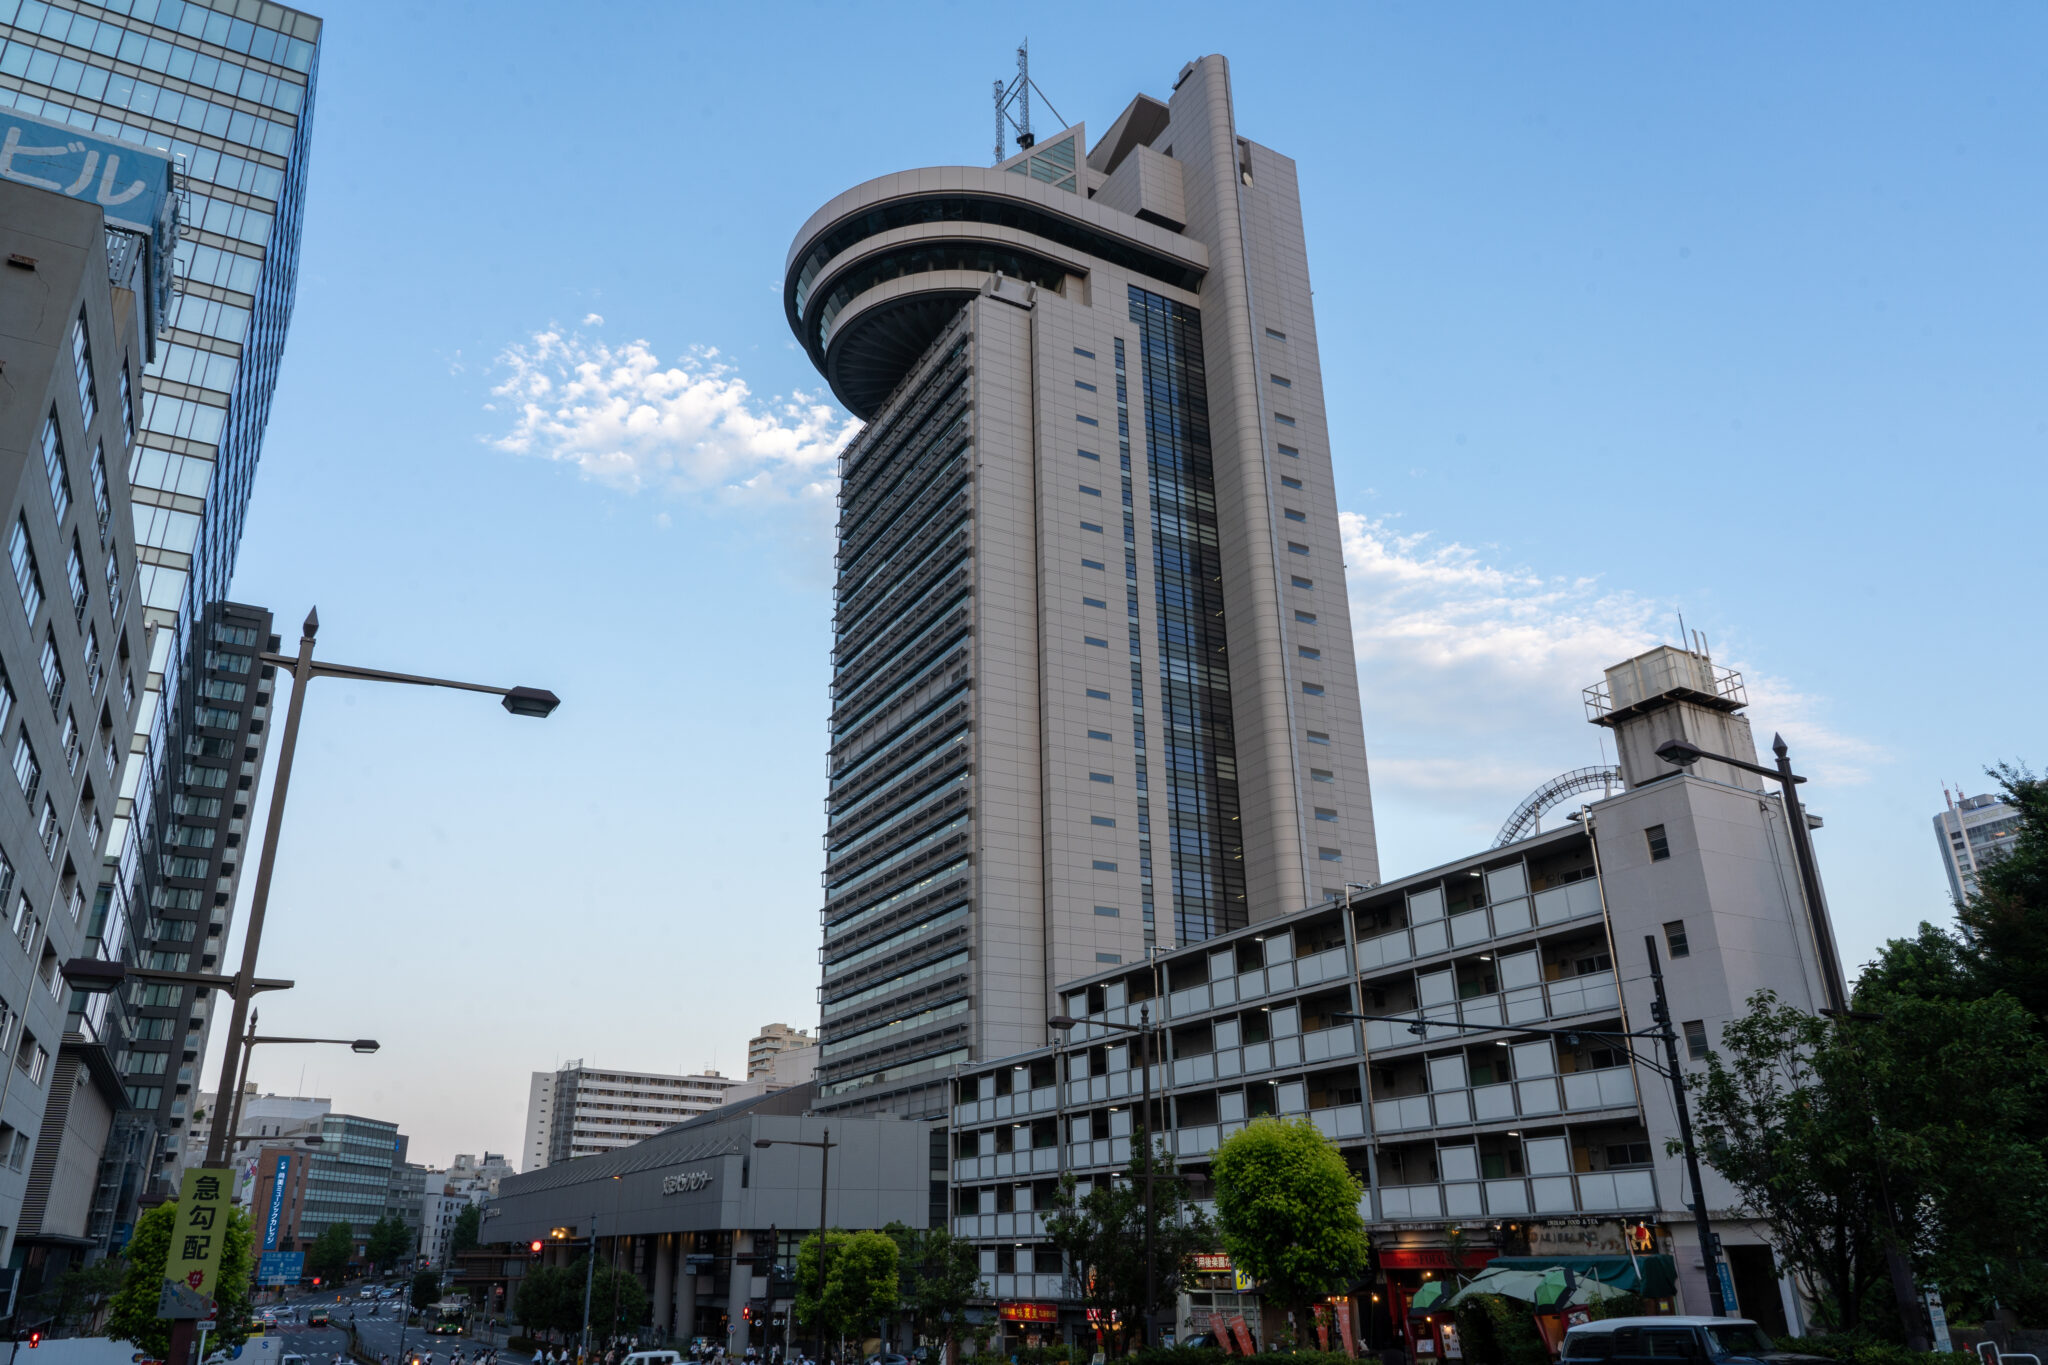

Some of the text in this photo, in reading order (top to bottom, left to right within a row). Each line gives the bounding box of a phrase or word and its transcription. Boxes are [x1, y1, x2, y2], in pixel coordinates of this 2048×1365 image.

[0, 126, 147, 207] ビル
[182, 1175, 220, 1260] 急勾配
